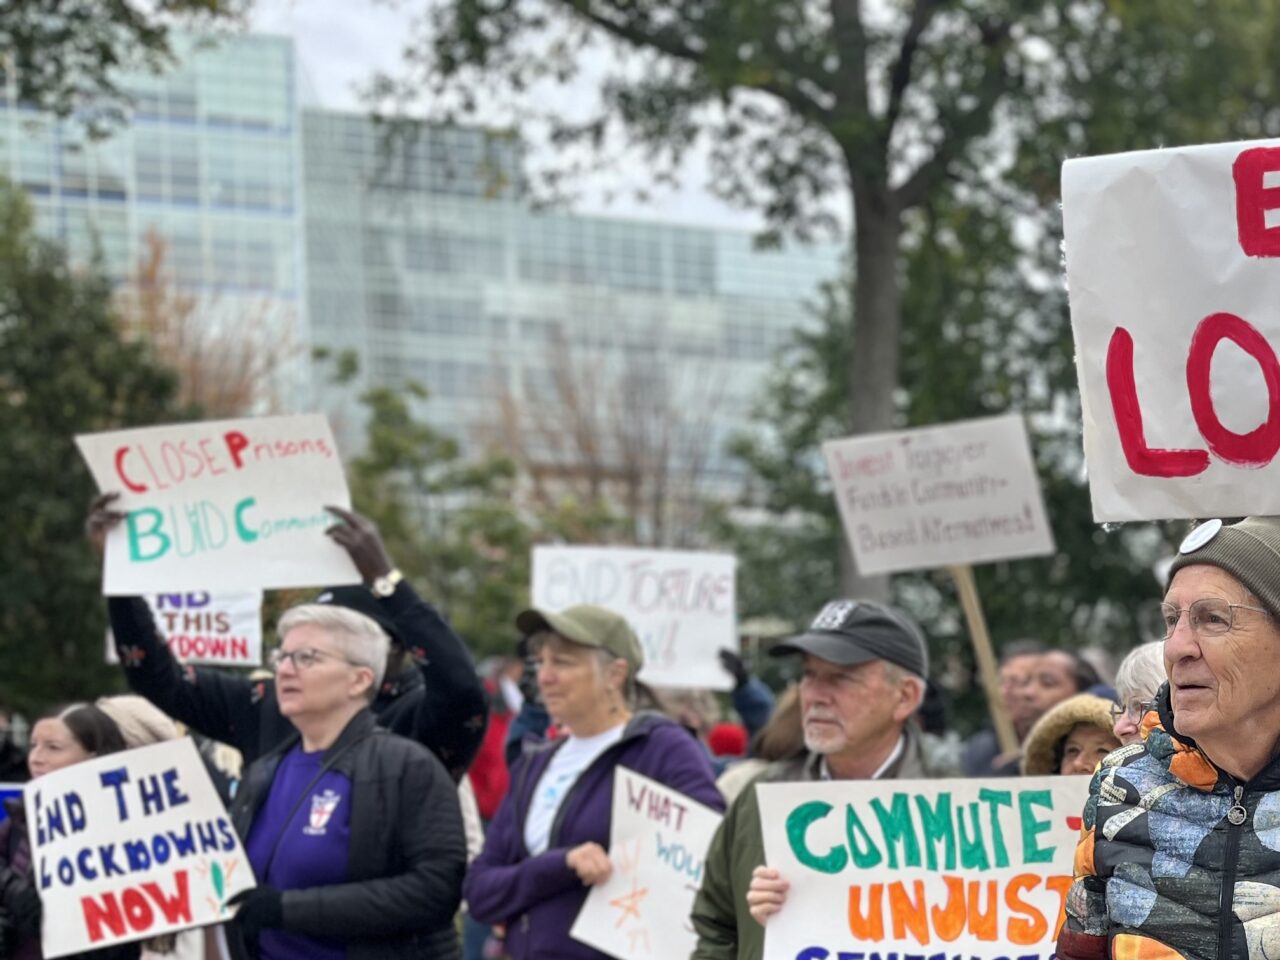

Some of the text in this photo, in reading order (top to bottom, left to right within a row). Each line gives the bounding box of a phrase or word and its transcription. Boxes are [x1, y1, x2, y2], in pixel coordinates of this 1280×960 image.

[156, 591, 210, 609] ND
[163, 611, 230, 633] THIS
[34, 767, 190, 847] END THE
[626, 777, 687, 832] WHAT
[785, 787, 1057, 875] COMMUTE
[41, 817, 236, 890] LOCKDOWNS
[848, 872, 1075, 946] UNJUST
